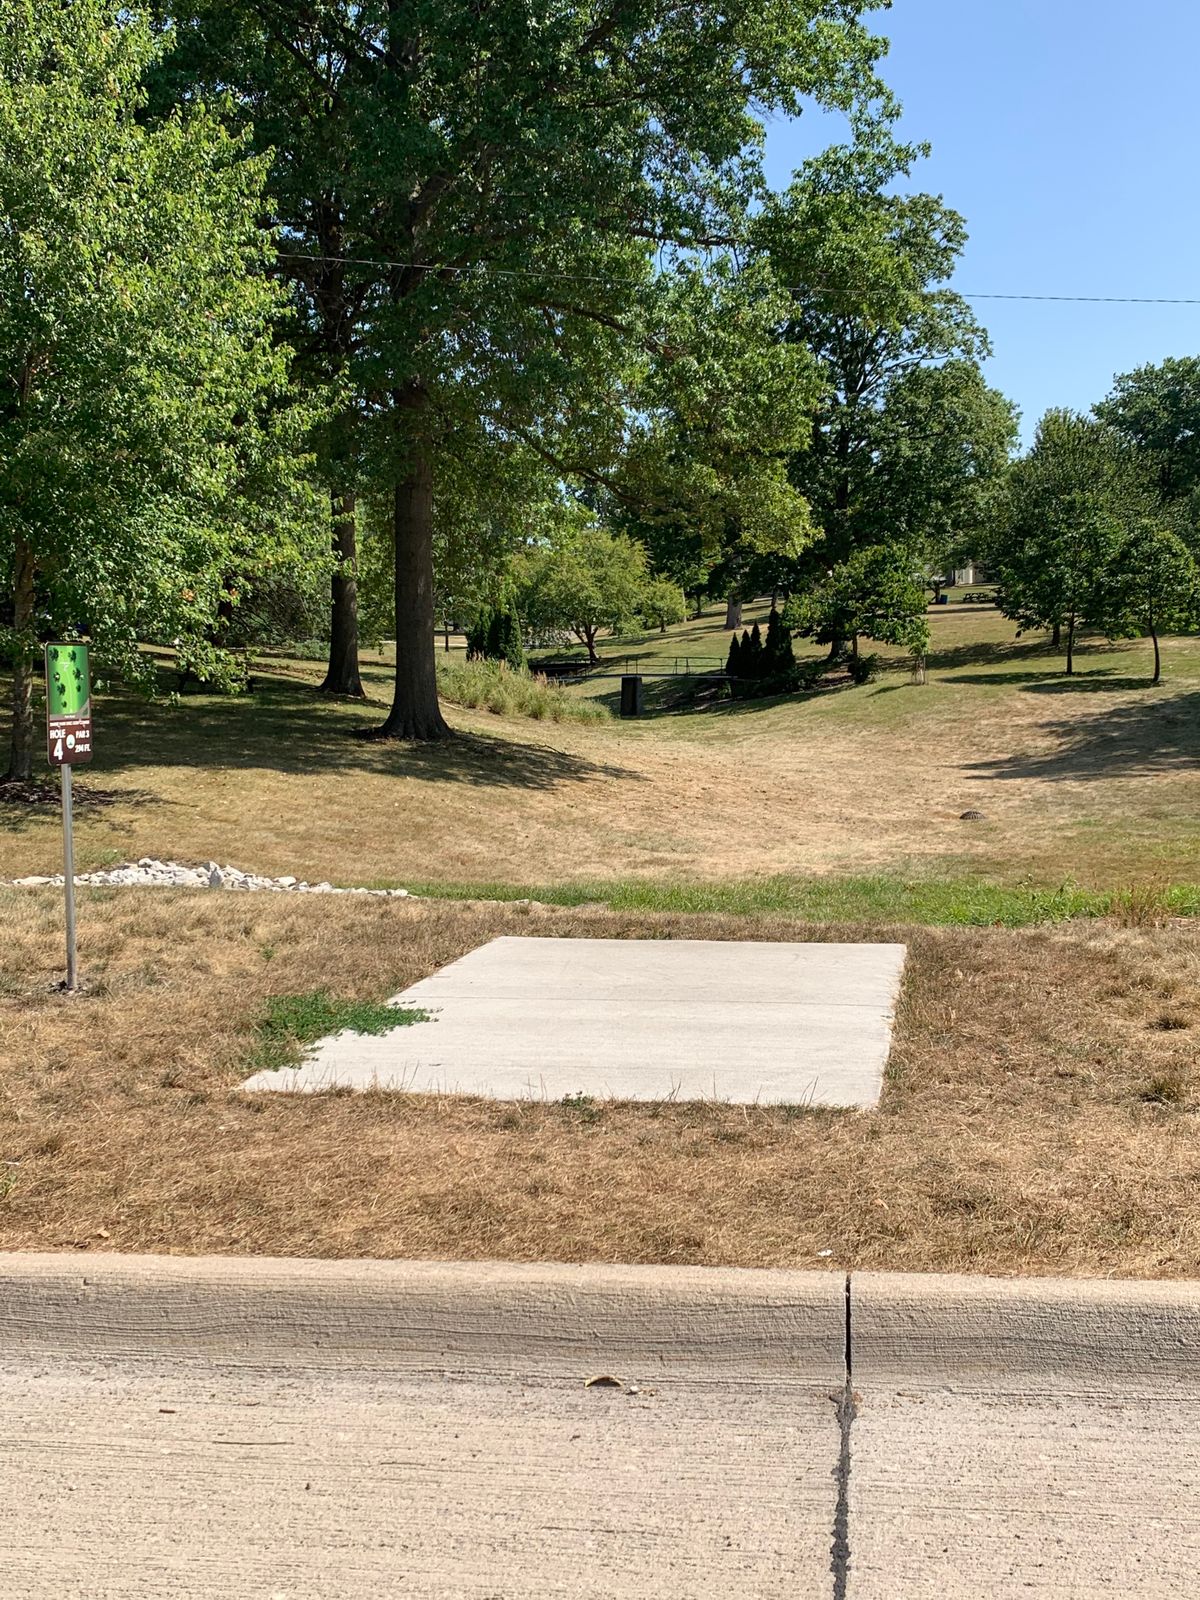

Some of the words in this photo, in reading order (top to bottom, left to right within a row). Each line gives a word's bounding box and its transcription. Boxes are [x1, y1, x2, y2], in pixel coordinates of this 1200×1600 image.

[50, 729, 66, 739] HOLE
[76, 730, 86, 738] PAR
[54, 739, 63, 760] 4
